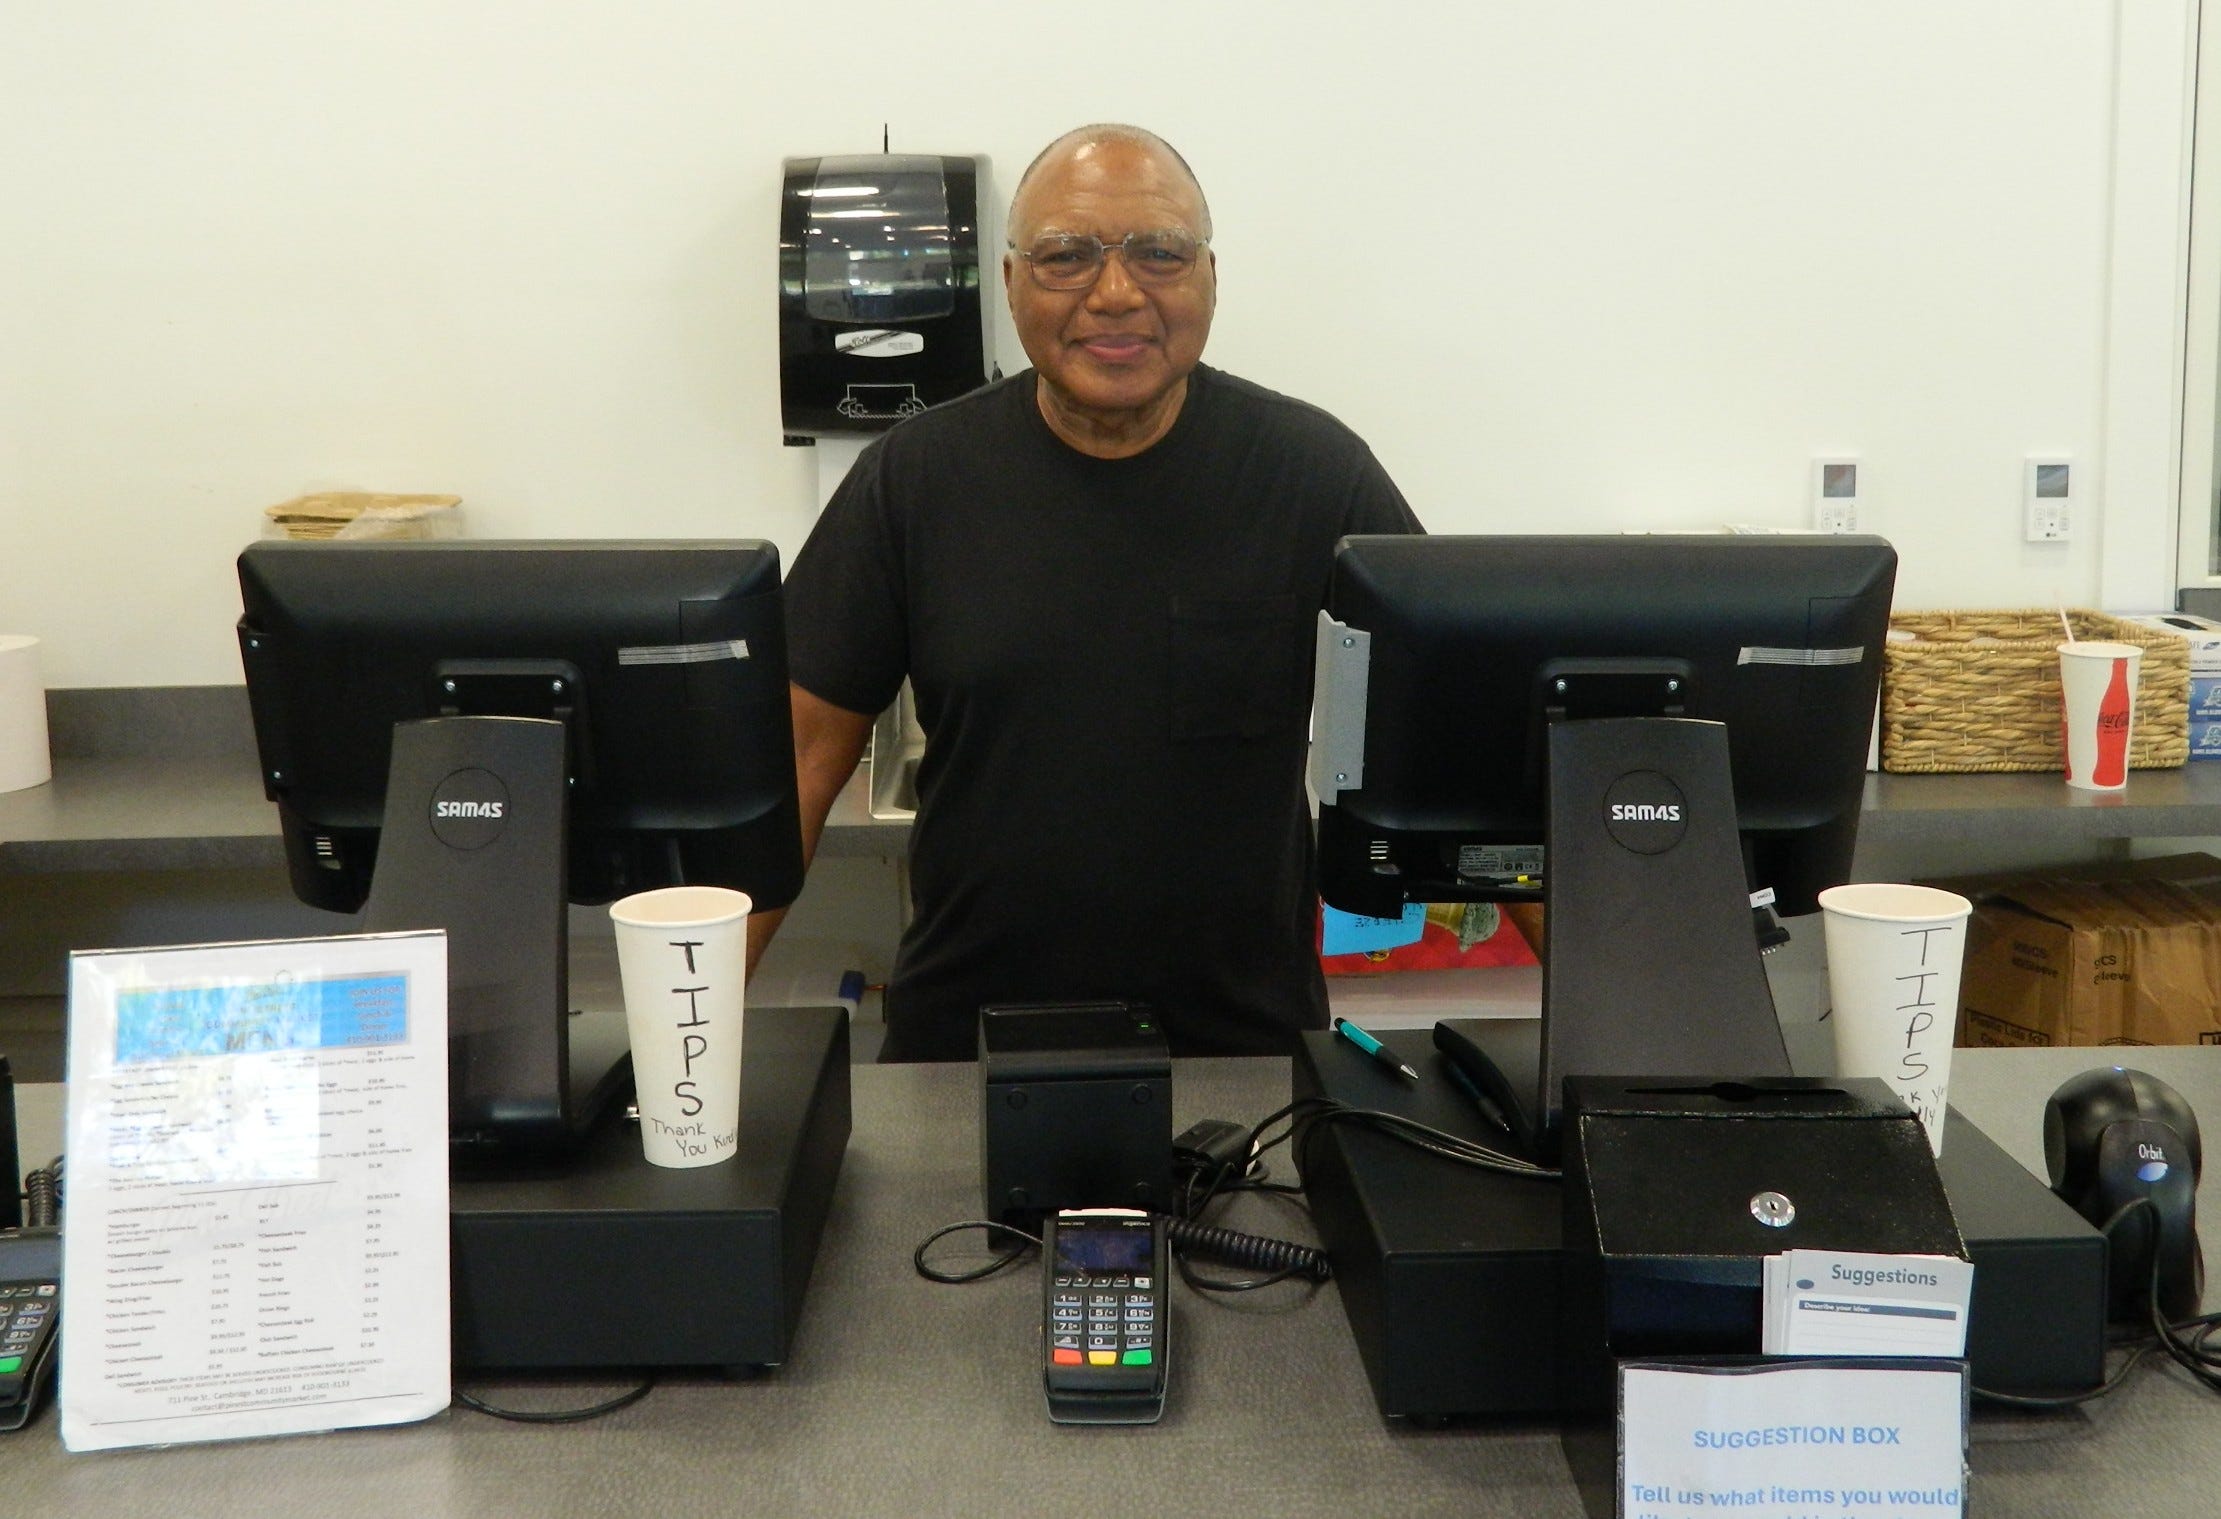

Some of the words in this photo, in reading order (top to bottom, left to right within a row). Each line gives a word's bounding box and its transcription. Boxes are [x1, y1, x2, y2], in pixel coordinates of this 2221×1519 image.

[437, 801, 503, 818] SAM4S
[1612, 805, 1680, 821] SAM4S
[1896, 927, 1952, 1080] TIPS
[669, 941, 711, 1116] TIPS
[651, 1117, 706, 1136] Thank
[676, 1140, 707, 1157] You
[2138, 1143, 2164, 1159] Orbit
[1831, 1264, 1938, 1287] Suggestions
[1693, 1426, 1846, 1449] SUGGESTION
[1852, 1427, 1900, 1446] BOX
[1631, 1484, 1670, 1504] Tell
[1677, 1490, 1704, 1505] us
[1709, 1487, 1764, 1506] what
[1771, 1486, 1835, 1504] items
[1842, 1490, 1882, 1508] you
[1888, 1487, 1959, 1506] would
